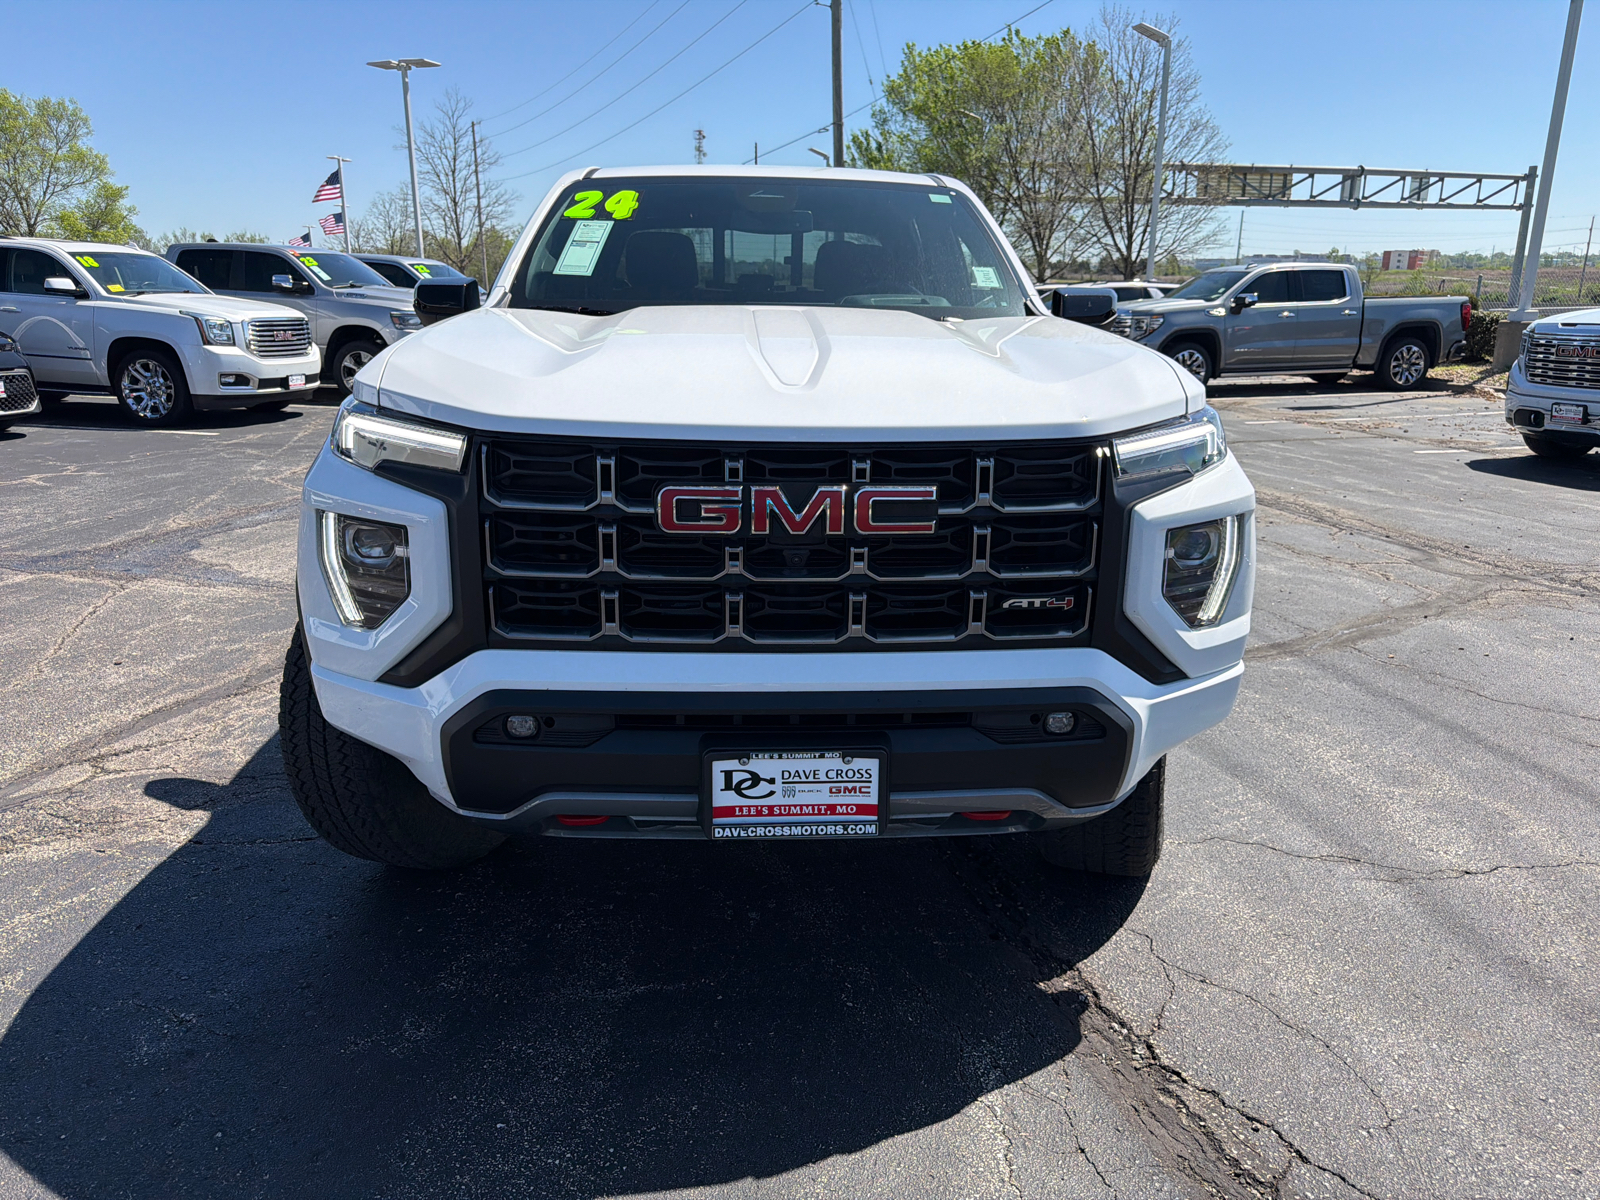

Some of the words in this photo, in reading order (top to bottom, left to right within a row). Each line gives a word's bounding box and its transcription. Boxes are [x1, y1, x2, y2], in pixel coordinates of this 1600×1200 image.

[563, 190, 639, 220] 24
[76, 256, 100, 268] 18
[1558, 346, 1600, 357] GMC
[657, 485, 937, 535] GMC
[1002, 597, 1074, 611] AT4
[781, 769, 820, 780] DAVE
[825, 768, 872, 779] CROSS
[829, 786, 871, 794] GMC
[773, 805, 831, 816] SUMMIT,
[835, 805, 857, 813] MO
[714, 824, 876, 838] DAVECROSSMOTORS.COM
